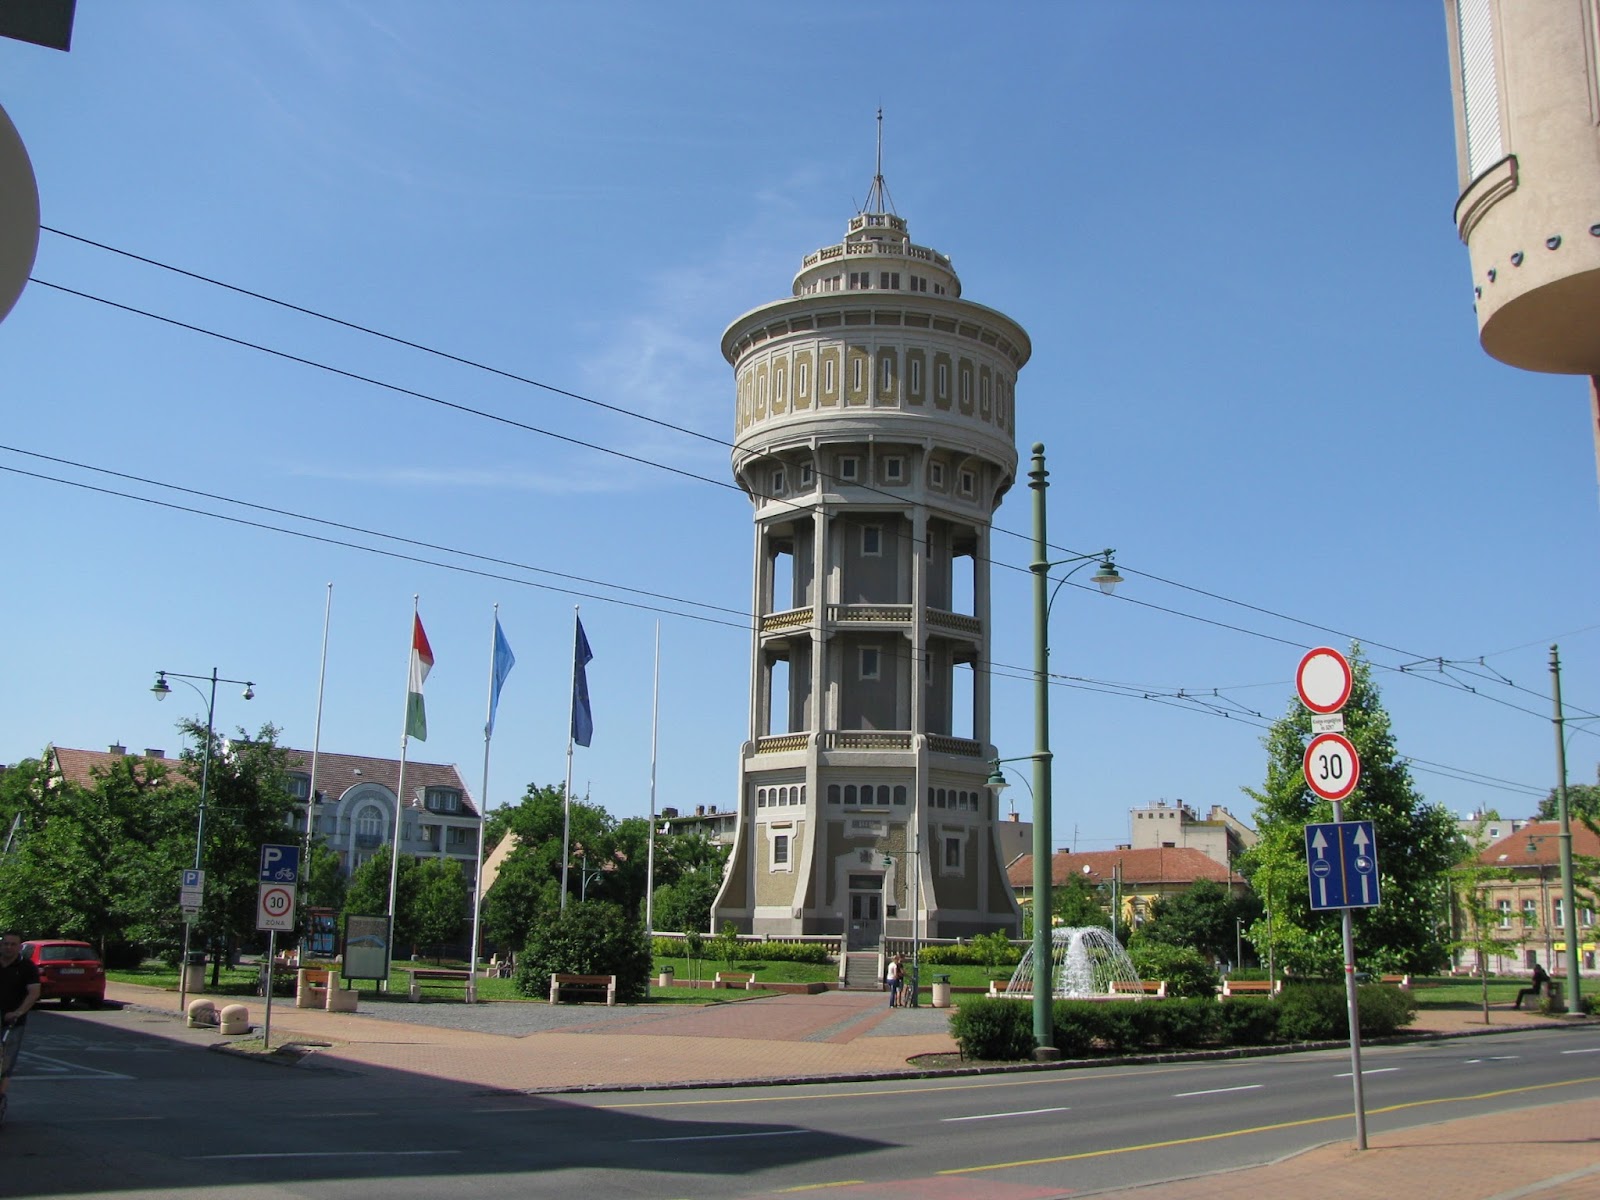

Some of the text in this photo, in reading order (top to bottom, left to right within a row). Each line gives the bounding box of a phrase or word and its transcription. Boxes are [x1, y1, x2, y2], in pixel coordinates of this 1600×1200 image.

[1319, 754, 1343, 780] 30
[264, 847, 282, 869] P
[186, 872, 196, 884] P
[270, 896, 284, 909] 30
